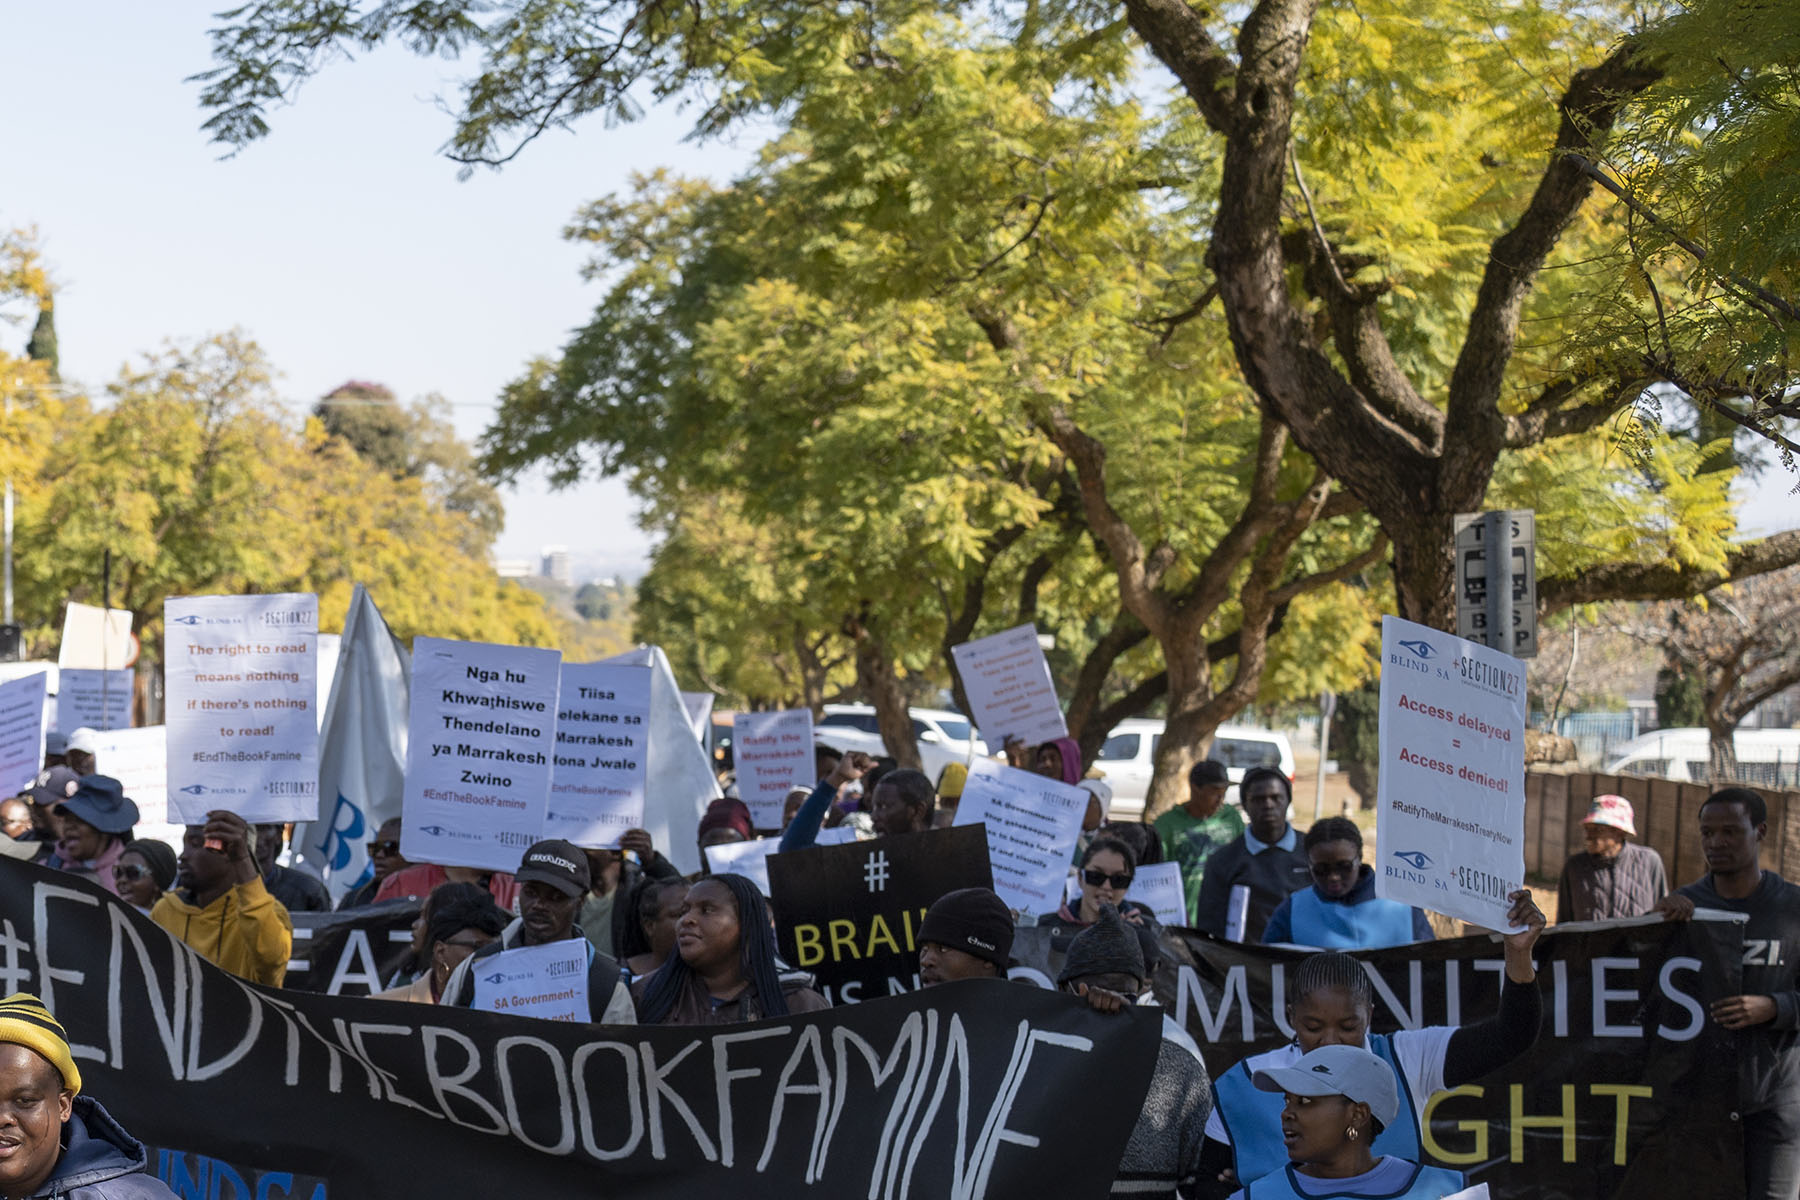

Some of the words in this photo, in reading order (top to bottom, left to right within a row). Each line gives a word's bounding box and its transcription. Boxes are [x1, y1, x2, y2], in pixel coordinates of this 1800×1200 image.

[1471, 609, 1522, 629] BS
[188, 645, 214, 655] The
[218, 645, 251, 658] right
[256, 645, 270, 654] to
[275, 643, 307, 654] read
[195, 673, 242, 682] means
[246, 670, 299, 683] nothing
[466, 666, 499, 683] Nga
[505, 669, 526, 683] hu
[1390, 654, 1429, 674] BLIND
[1436, 668, 1449, 680] SA
[1453, 656, 1519, 696] +SECTION27
[578, 688, 615, 700] Tiisa
[187, 699, 197, 710] if
[201, 699, 249, 710] there's
[254, 698, 307, 711] nothing
[443, 716, 541, 738] Thendelano
[558, 710, 618, 724] elekane
[624, 714, 641, 725] sa
[1399, 695, 1453, 722] Access
[1458, 712, 1511, 741] delayed
[220, 727, 234, 736] to
[239, 726, 275, 736] read!
[555, 732, 633, 747] Marrakesh
[193, 751, 302, 763] #EndTheBookFamine
[432, 743, 451, 756] ya
[456, 744, 546, 765] Marrakesh
[591, 757, 637, 770] Jwale
[460, 770, 512, 787] Zwino
[1399, 748, 1454, 775] Access
[1458, 766, 1509, 793] denied!
[423, 789, 526, 809] #EndTheBookFamine
[552, 784, 632, 797] EndTheBookFamine
[1392, 800, 1512, 845] #RatifyTheMarrakeshTreatyNow
[863, 850, 890, 892] #
[1385, 865, 1426, 885] BLIND
[1434, 879, 1448, 891] SA
[494, 997, 508, 1009] SA
[511, 988, 574, 1007] Government
[1421, 1084, 1653, 1165] GHT
